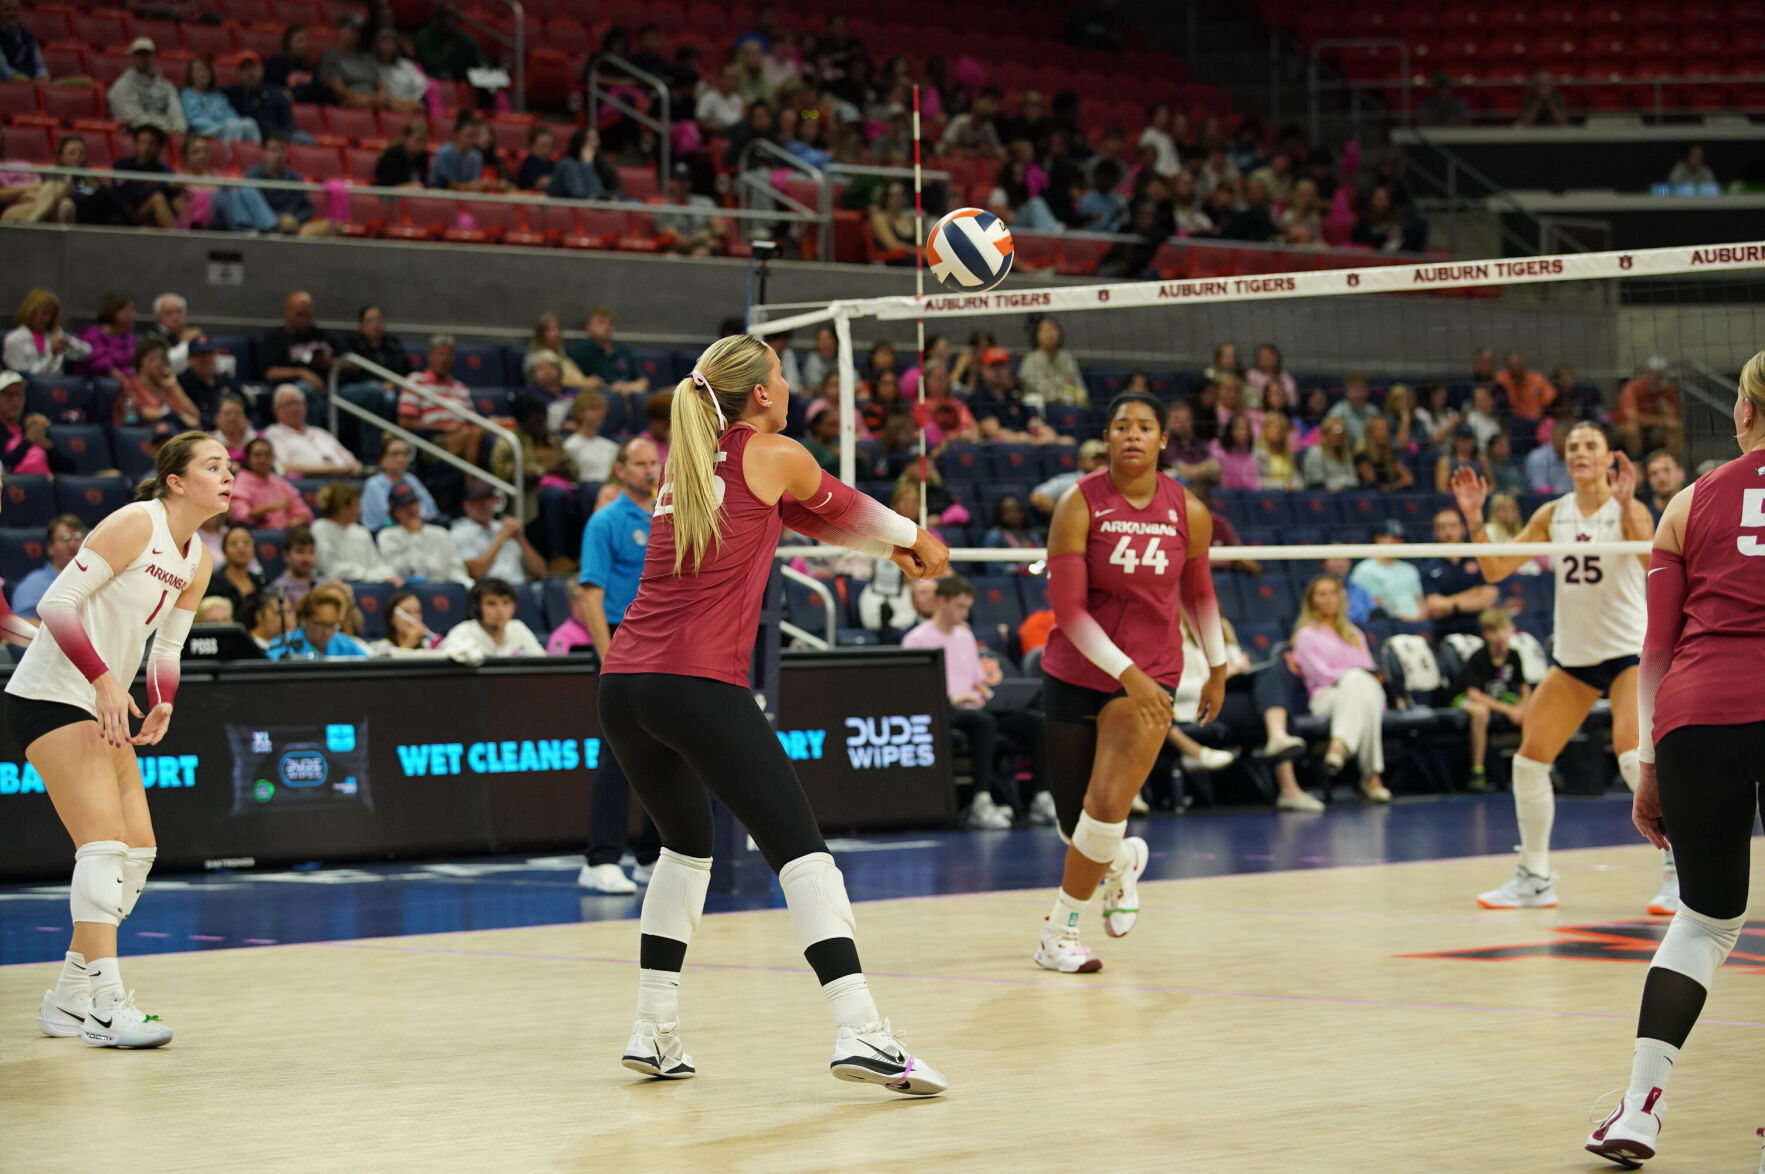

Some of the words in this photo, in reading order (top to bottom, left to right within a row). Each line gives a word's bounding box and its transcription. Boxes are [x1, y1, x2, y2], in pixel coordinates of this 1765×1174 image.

[1413, 264, 1488, 283] AUBURN
[1495, 260, 1563, 277] TIGERS
[1158, 281, 1228, 298] AUBURN
[1234, 277, 1296, 294] TIGERS
[924, 296, 989, 312] AUBURN
[997, 293, 1050, 307] TIGERS
[1100, 520, 1177, 537] ARKANSAS
[1109, 535, 1169, 575] 44
[145, 563, 188, 591] ARKANSA
[1563, 555, 1603, 584] 25
[145, 589, 168, 625] 1
[845, 714, 934, 747] DUDE
[397, 742, 464, 777] WET
[467, 738, 580, 774] CLEANS
[848, 743, 935, 770] WIPES
